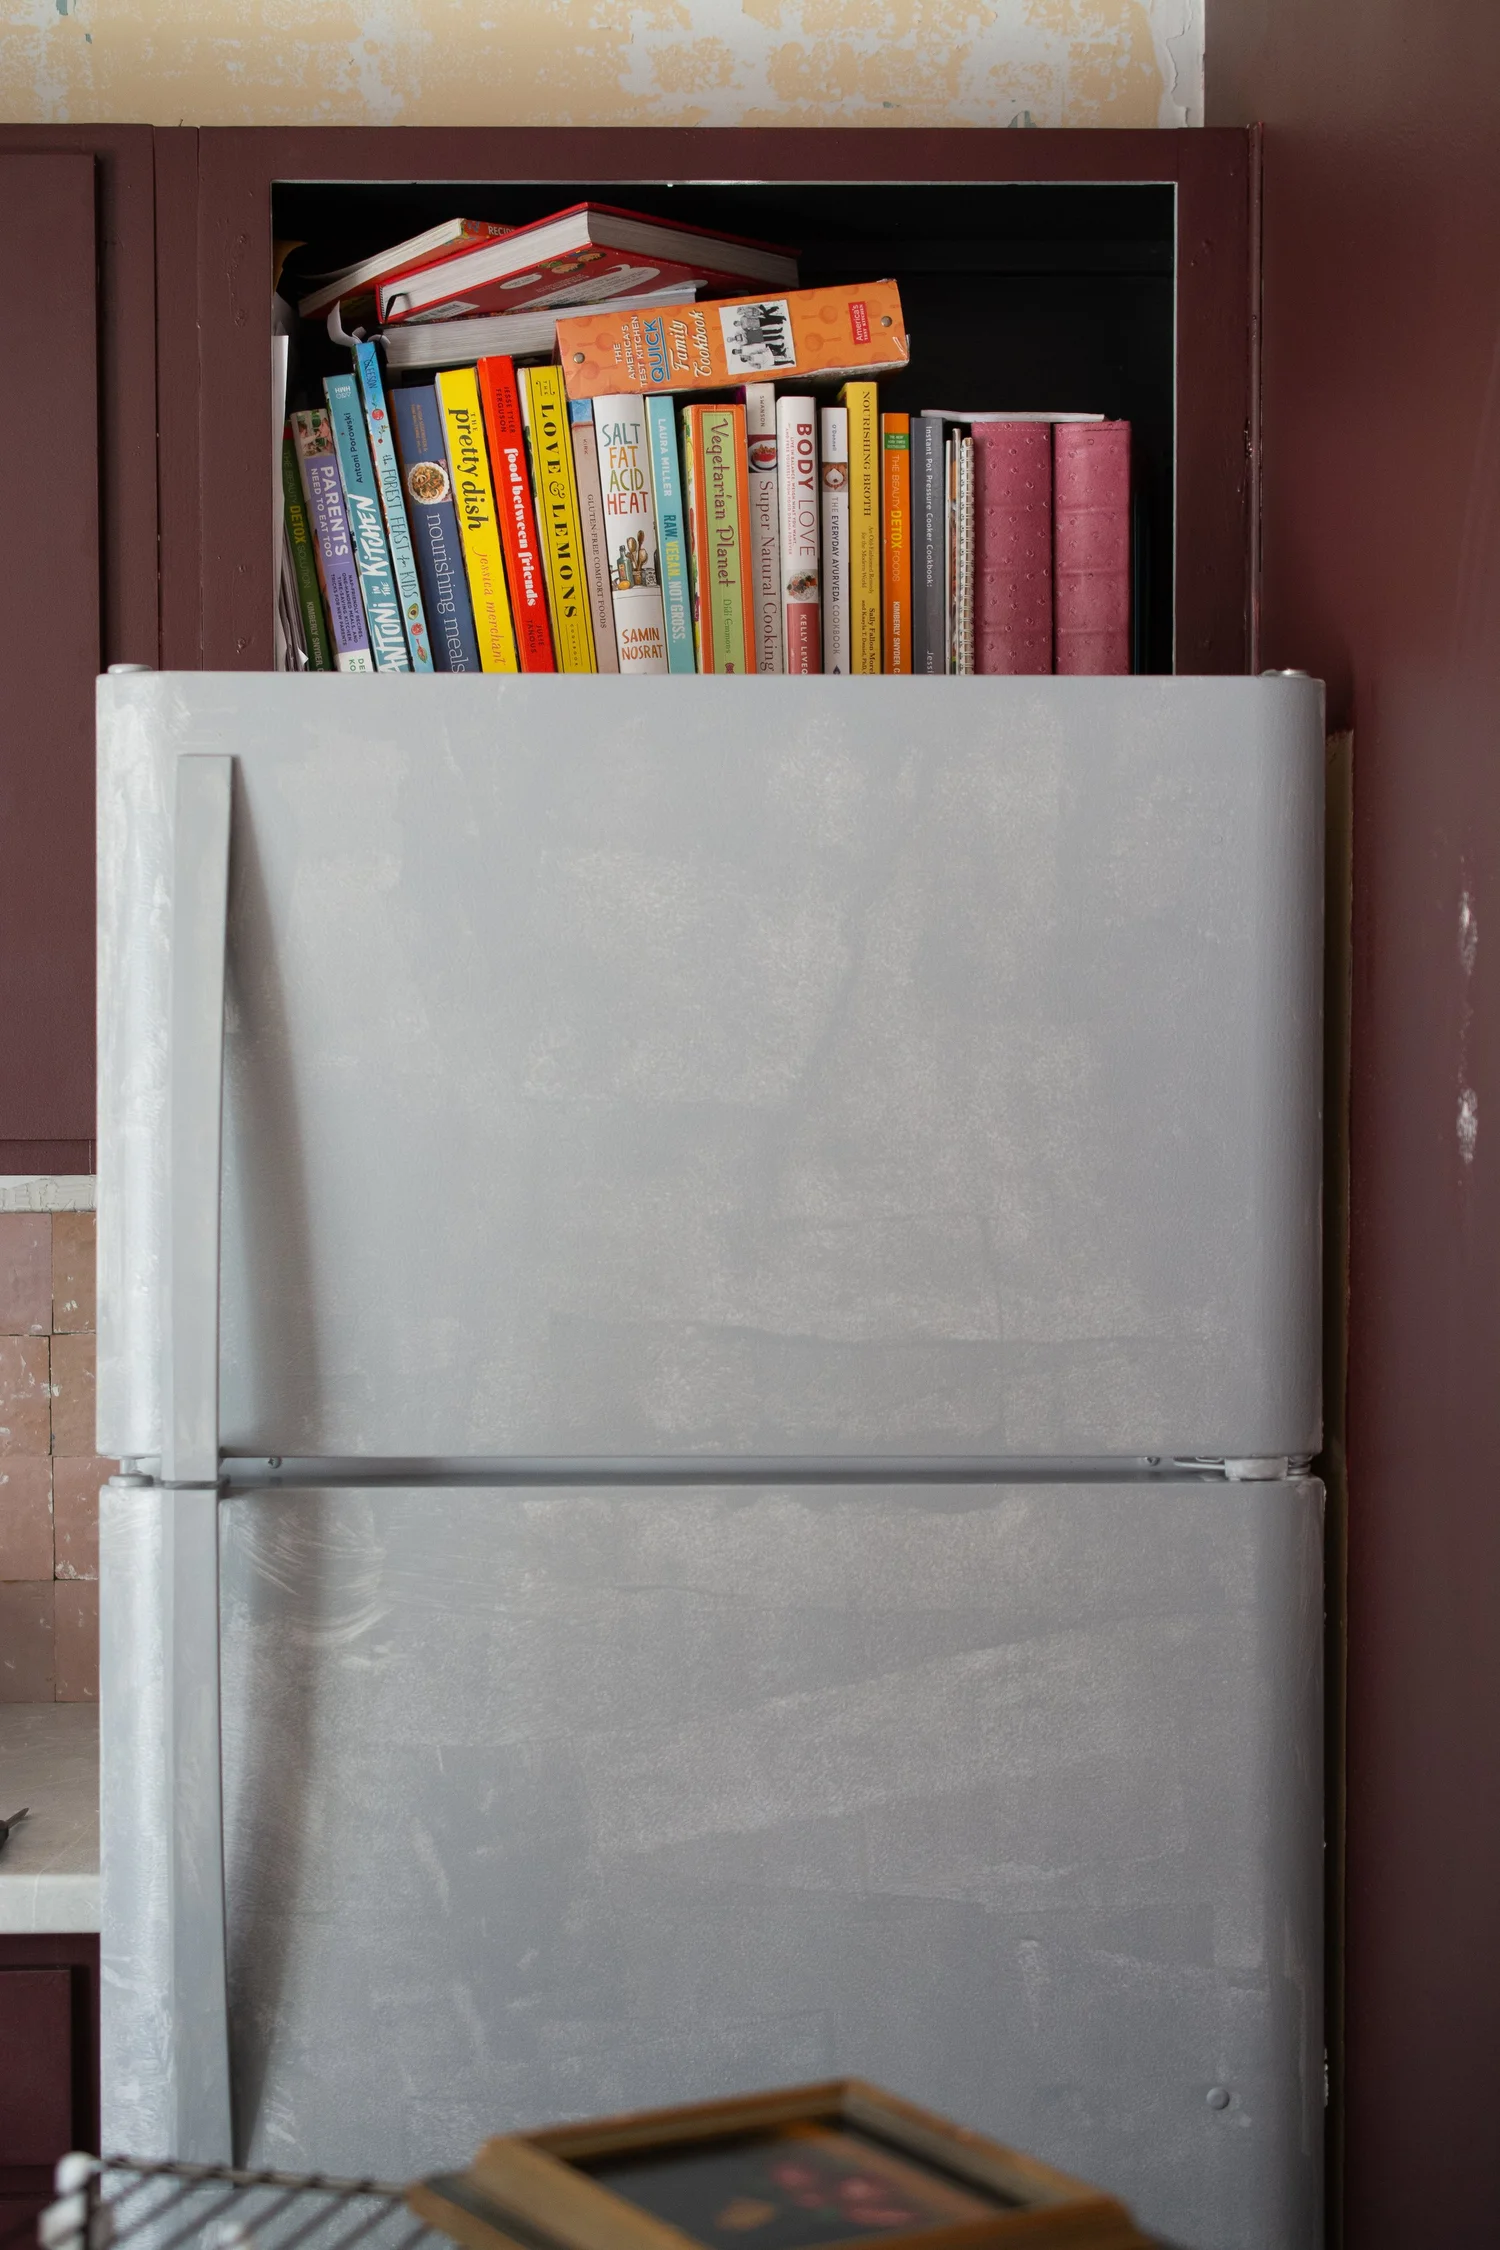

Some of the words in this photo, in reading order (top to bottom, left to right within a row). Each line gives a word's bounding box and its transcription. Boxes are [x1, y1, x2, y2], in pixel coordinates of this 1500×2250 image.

[631, 316, 644, 361] KITCHEN
[852, 304, 863, 342] America's
[613, 343, 622, 365] THE
[622, 325, 636, 380] AMERICA'S
[643, 318, 666, 383] QUICK
[668, 319, 690, 372] Family
[688, 309, 712, 378] Cookbook
[363, 359, 378, 389] GLEESON
[637, 363, 648, 388] TEST
[496, 388, 507, 433] FERGUSON
[504, 386, 513, 408] JESSE
[343, 412, 357, 453] Porowski
[470, 413, 478, 432] THE
[506, 410, 516, 434] TYLER
[541, 404, 562, 474] LOVE
[601, 423, 641, 447] SALT
[658, 418, 669, 455] LAURA
[862, 391, 871, 470] NOURISHING
[283, 452, 292, 468] THE
[448, 408, 480, 477] pretty
[608, 446, 639, 469] FAT
[796, 424, 814, 491] BODY
[310, 468, 321, 495] NEED
[350, 454, 363, 484] Antoni
[503, 448, 522, 483] food
[609, 467, 644, 493] ACID
[661, 457, 672, 497] MILLER
[705, 418, 733, 520] Vegetarian
[892, 455, 900, 472] THE
[286, 470, 298, 504] BEAUTY
[316, 498, 325, 511] TO
[381, 469, 403, 510] FOREST
[461, 480, 489, 531] dish
[549, 481, 566, 499] &
[606, 491, 649, 515] HEAT
[756, 480, 773, 531] Super
[831, 497, 839, 513] THE
[863, 473, 872, 517] BROTH
[892, 474, 900, 509] BEAUTY
[289, 505, 307, 544] DETOX
[319, 515, 329, 533] EAT
[320, 466, 349, 556] PARENTS
[511, 485, 529, 549] between
[587, 494, 600, 555] GLUTEN-FREE
[663, 514, 678, 540] RAW.
[798, 499, 816, 557] LOVE
[891, 510, 902, 549] DETOX
[323, 536, 333, 557] TOO
[390, 516, 411, 550] FEAST
[831, 515, 841, 557] EVERYDAY
[299, 545, 312, 589] SOLUTION
[552, 504, 578, 619] LEMONS
[715, 525, 736, 588] Planet
[760, 536, 777, 597] Natural
[892, 551, 900, 582] FOODS
[926, 544, 934, 587] Cookbook:
[342, 573, 352, 610] ONE-HANDED
[348, 575, 359, 615] NAP-FRIENDLY
[399, 571, 419, 599] KIDS
[427, 513, 457, 615] nourishing
[443, 618, 469, 674] meals
[517, 551, 539, 607] friends
[592, 557, 604, 598] COMFORT
[668, 581, 682, 605] NOT
[831, 558, 840, 603] AYURVEDA
[306, 601, 318, 636] KIMBERLY
[597, 600, 607, 629] FOODS
[670, 605, 686, 643] GROSS.
[723, 599, 733, 616] Didi
[893, 601, 901, 636] KIMBERLY
[339, 620, 347, 645] PARENTS
[344, 615, 352, 641] KITCHEN
[485, 601, 507, 666] merchant
[525, 619, 537, 654] TANOUS
[536, 624, 545, 646] JULIE
[570, 623, 578, 667] COOKBOOK
[622, 627, 660, 644] SAMIN
[760, 602, 778, 672] Cooking
[800, 614, 808, 643] KELLY
[832, 604, 841, 655] COOKBOOK
[621, 644, 663, 661] NOSRAT
